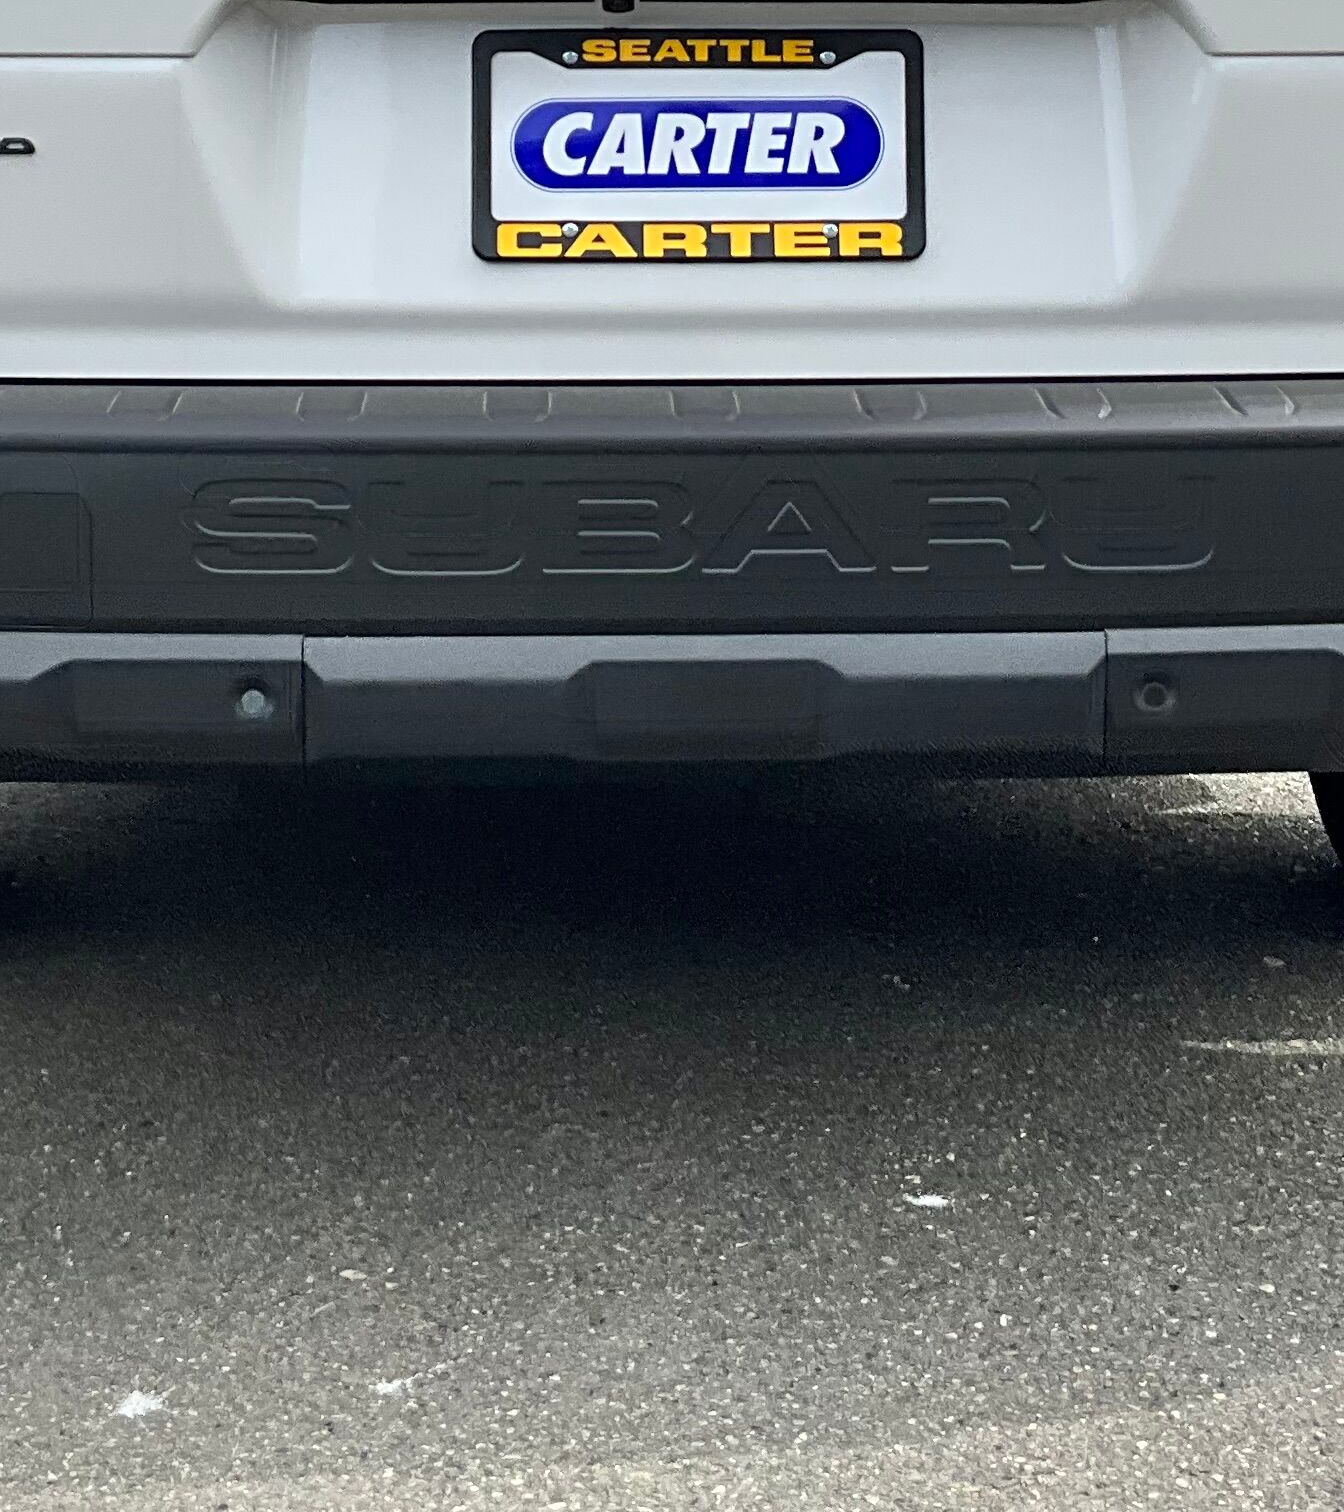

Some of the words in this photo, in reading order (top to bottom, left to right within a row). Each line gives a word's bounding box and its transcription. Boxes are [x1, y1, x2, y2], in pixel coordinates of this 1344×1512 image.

[582, 39, 814, 63] SEATTLE
[543, 112, 845, 176] CARTER
[497, 223, 903, 257] CARTER
[191, 477, 1216, 575] SUBARU
